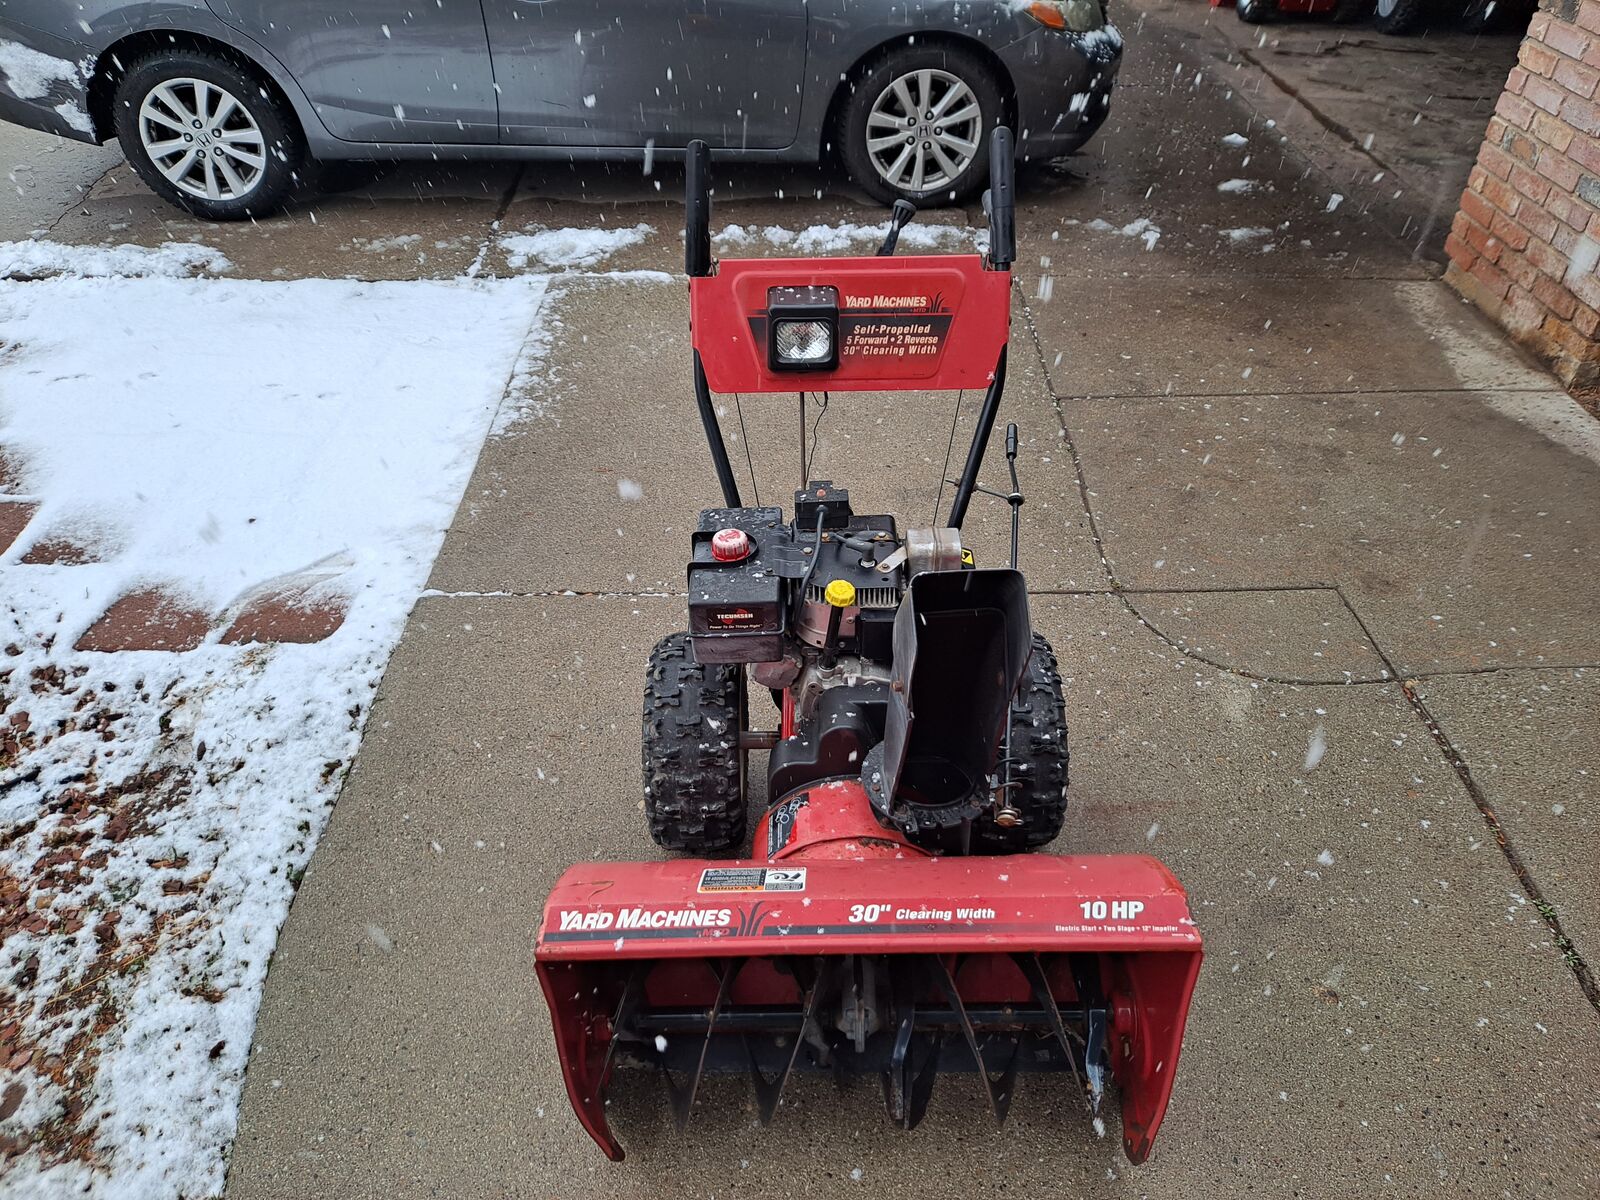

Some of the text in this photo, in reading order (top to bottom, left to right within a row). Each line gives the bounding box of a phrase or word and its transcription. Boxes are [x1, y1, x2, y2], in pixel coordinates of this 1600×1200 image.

[845, 295, 927, 308] YARD MACHINES
[853, 324, 931, 335] Self-Propelled
[846, 335, 938, 344] 5 Forward 2 Reverse
[843, 345, 937, 356] 30" Clearing Width
[848, 904, 995, 923] 30" Clearing Width
[1080, 901, 1145, 920] 10 HP
[559, 908, 732, 931] YARD MACHINES
[1117, 925, 1135, 933] Stage
[1152, 925, 1178, 933] Impeller
